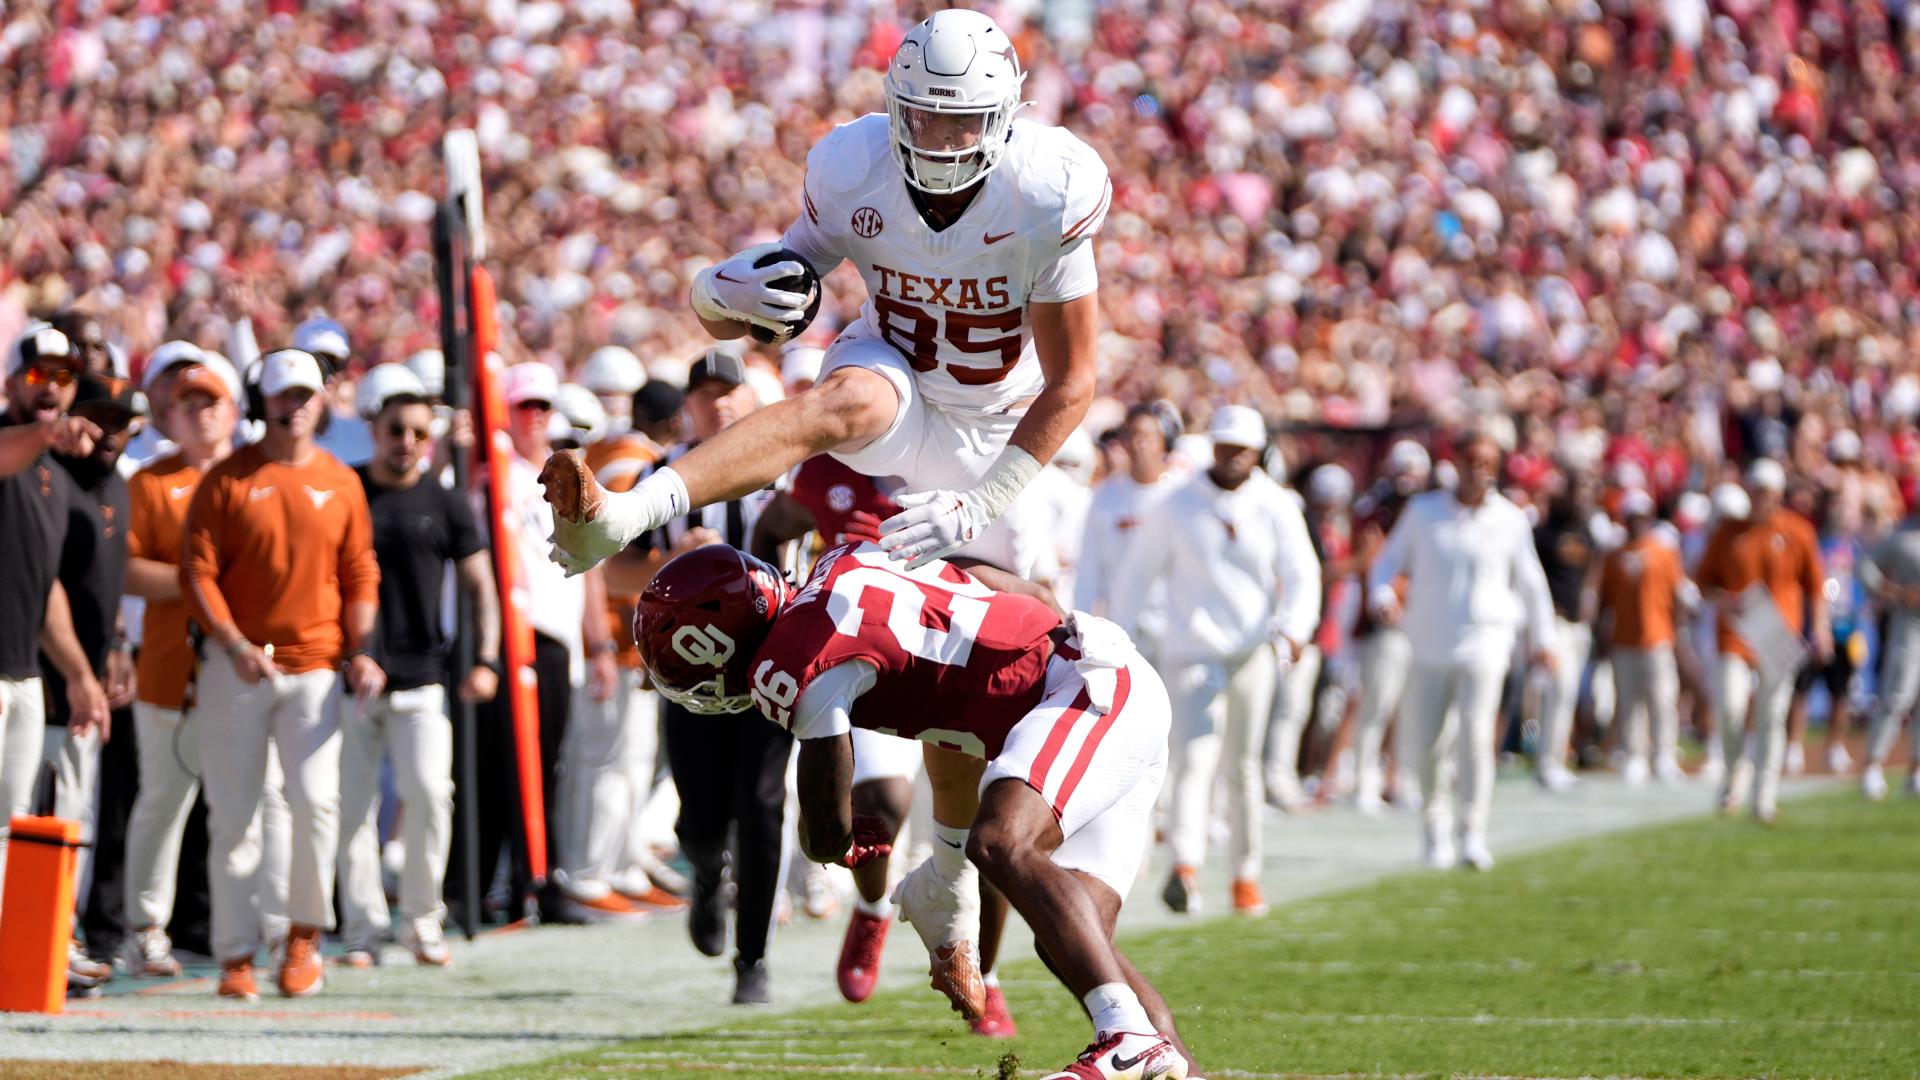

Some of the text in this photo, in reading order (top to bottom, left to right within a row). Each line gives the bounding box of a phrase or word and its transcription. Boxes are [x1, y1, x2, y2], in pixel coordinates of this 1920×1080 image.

[929, 87, 956, 97] HORNS
[853, 208, 882, 237] SEC
[872, 264, 1010, 310] TEXAS
[875, 295, 1022, 385] 85
[672, 623, 735, 668] OU
[751, 659, 799, 730] 26
